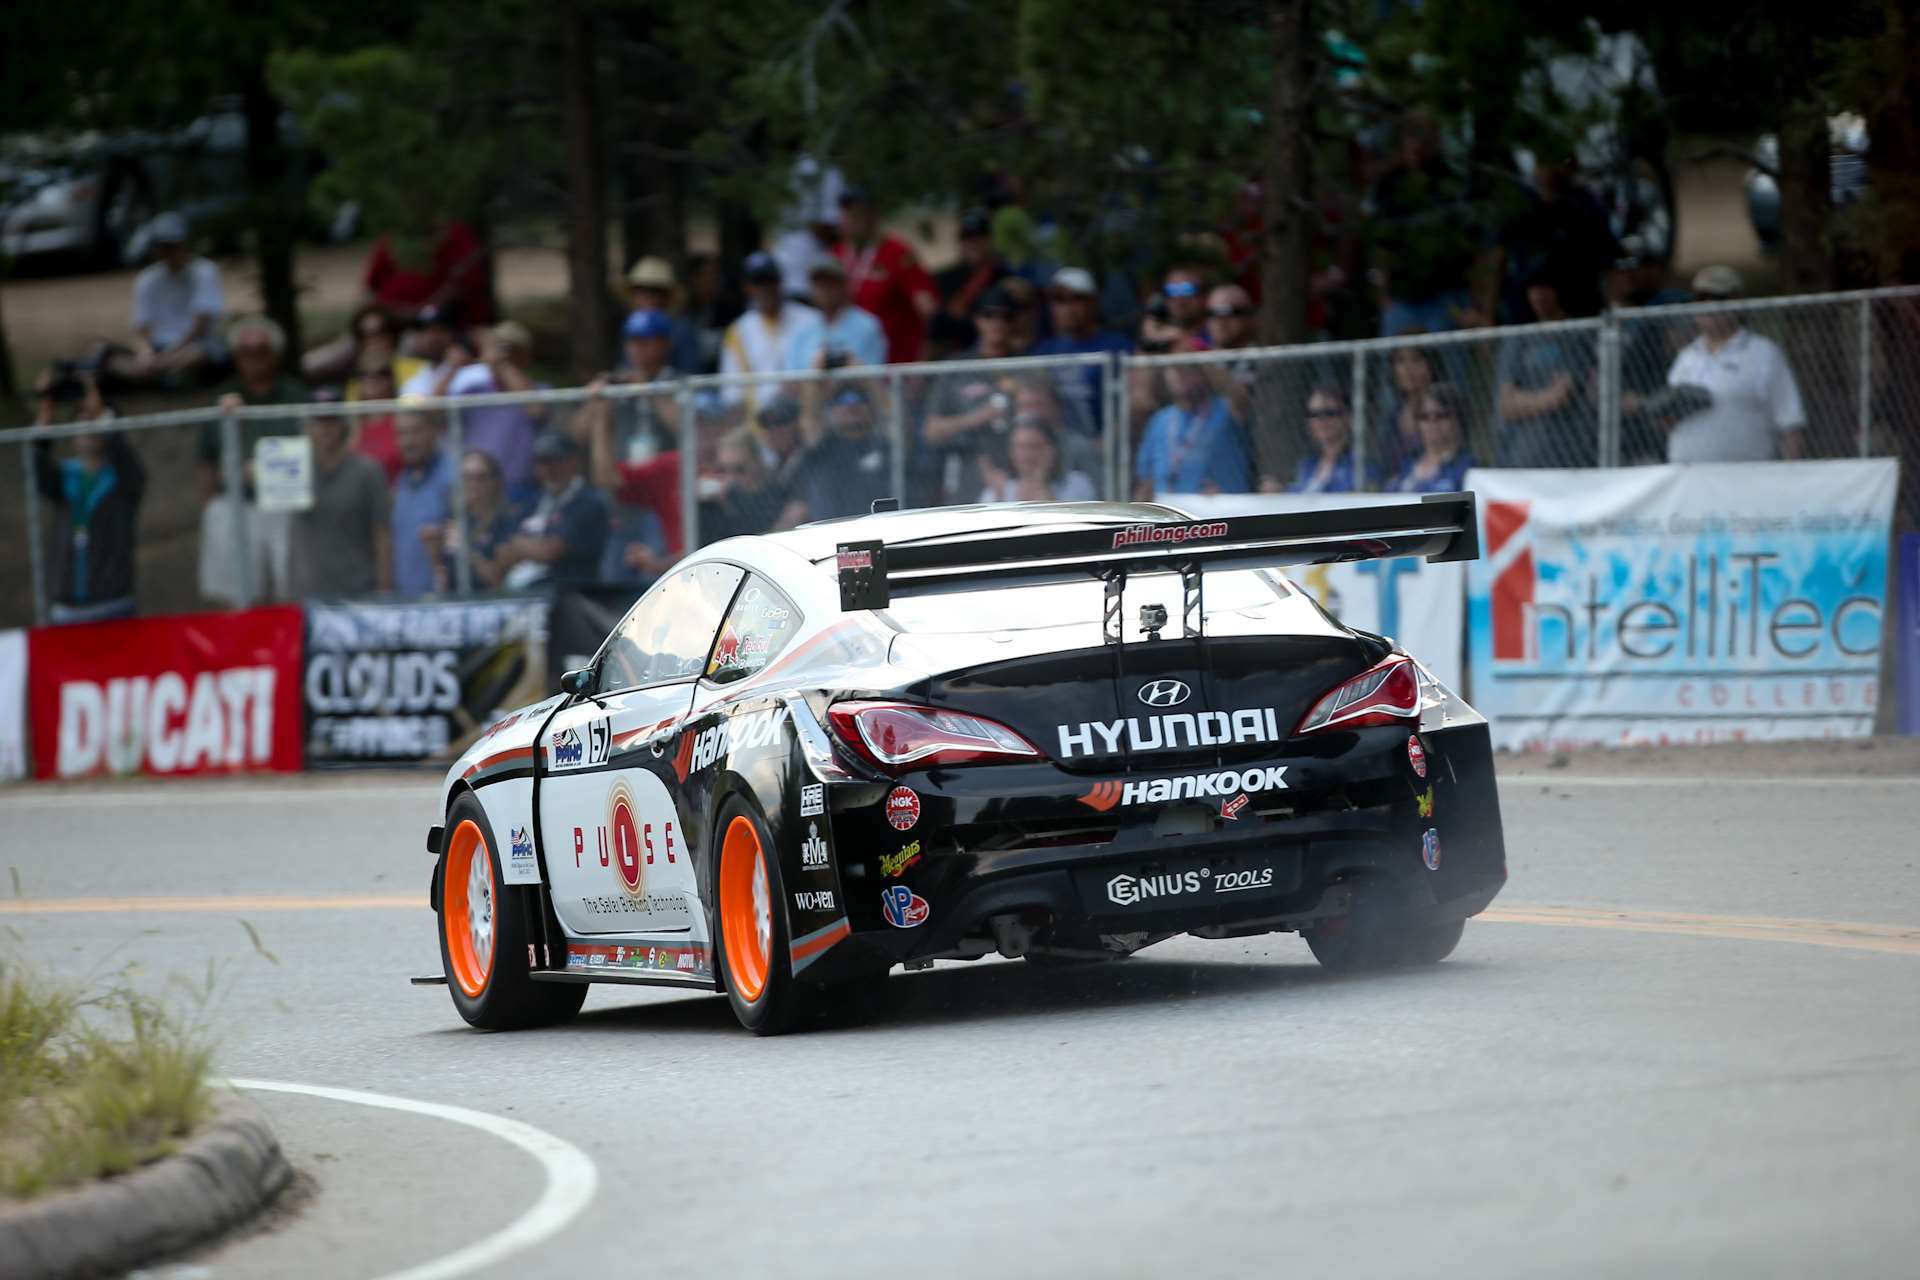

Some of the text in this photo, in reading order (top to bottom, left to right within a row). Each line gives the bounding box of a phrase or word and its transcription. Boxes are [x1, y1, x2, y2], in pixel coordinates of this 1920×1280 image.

[1112, 522, 1228, 549] phillong.com
[306, 651, 461, 713] CLOUDS
[1677, 680, 1877, 708] COLLEGE
[56, 665, 277, 777] DUCATI
[1057, 707, 1279, 758] HYUNDAI
[890, 796, 914, 808] NGK
[573, 821, 676, 868] PULSE
[1214, 868, 1273, 891] TOOLS
[582, 897, 601, 914] The
[881, 885, 913, 928] VP
